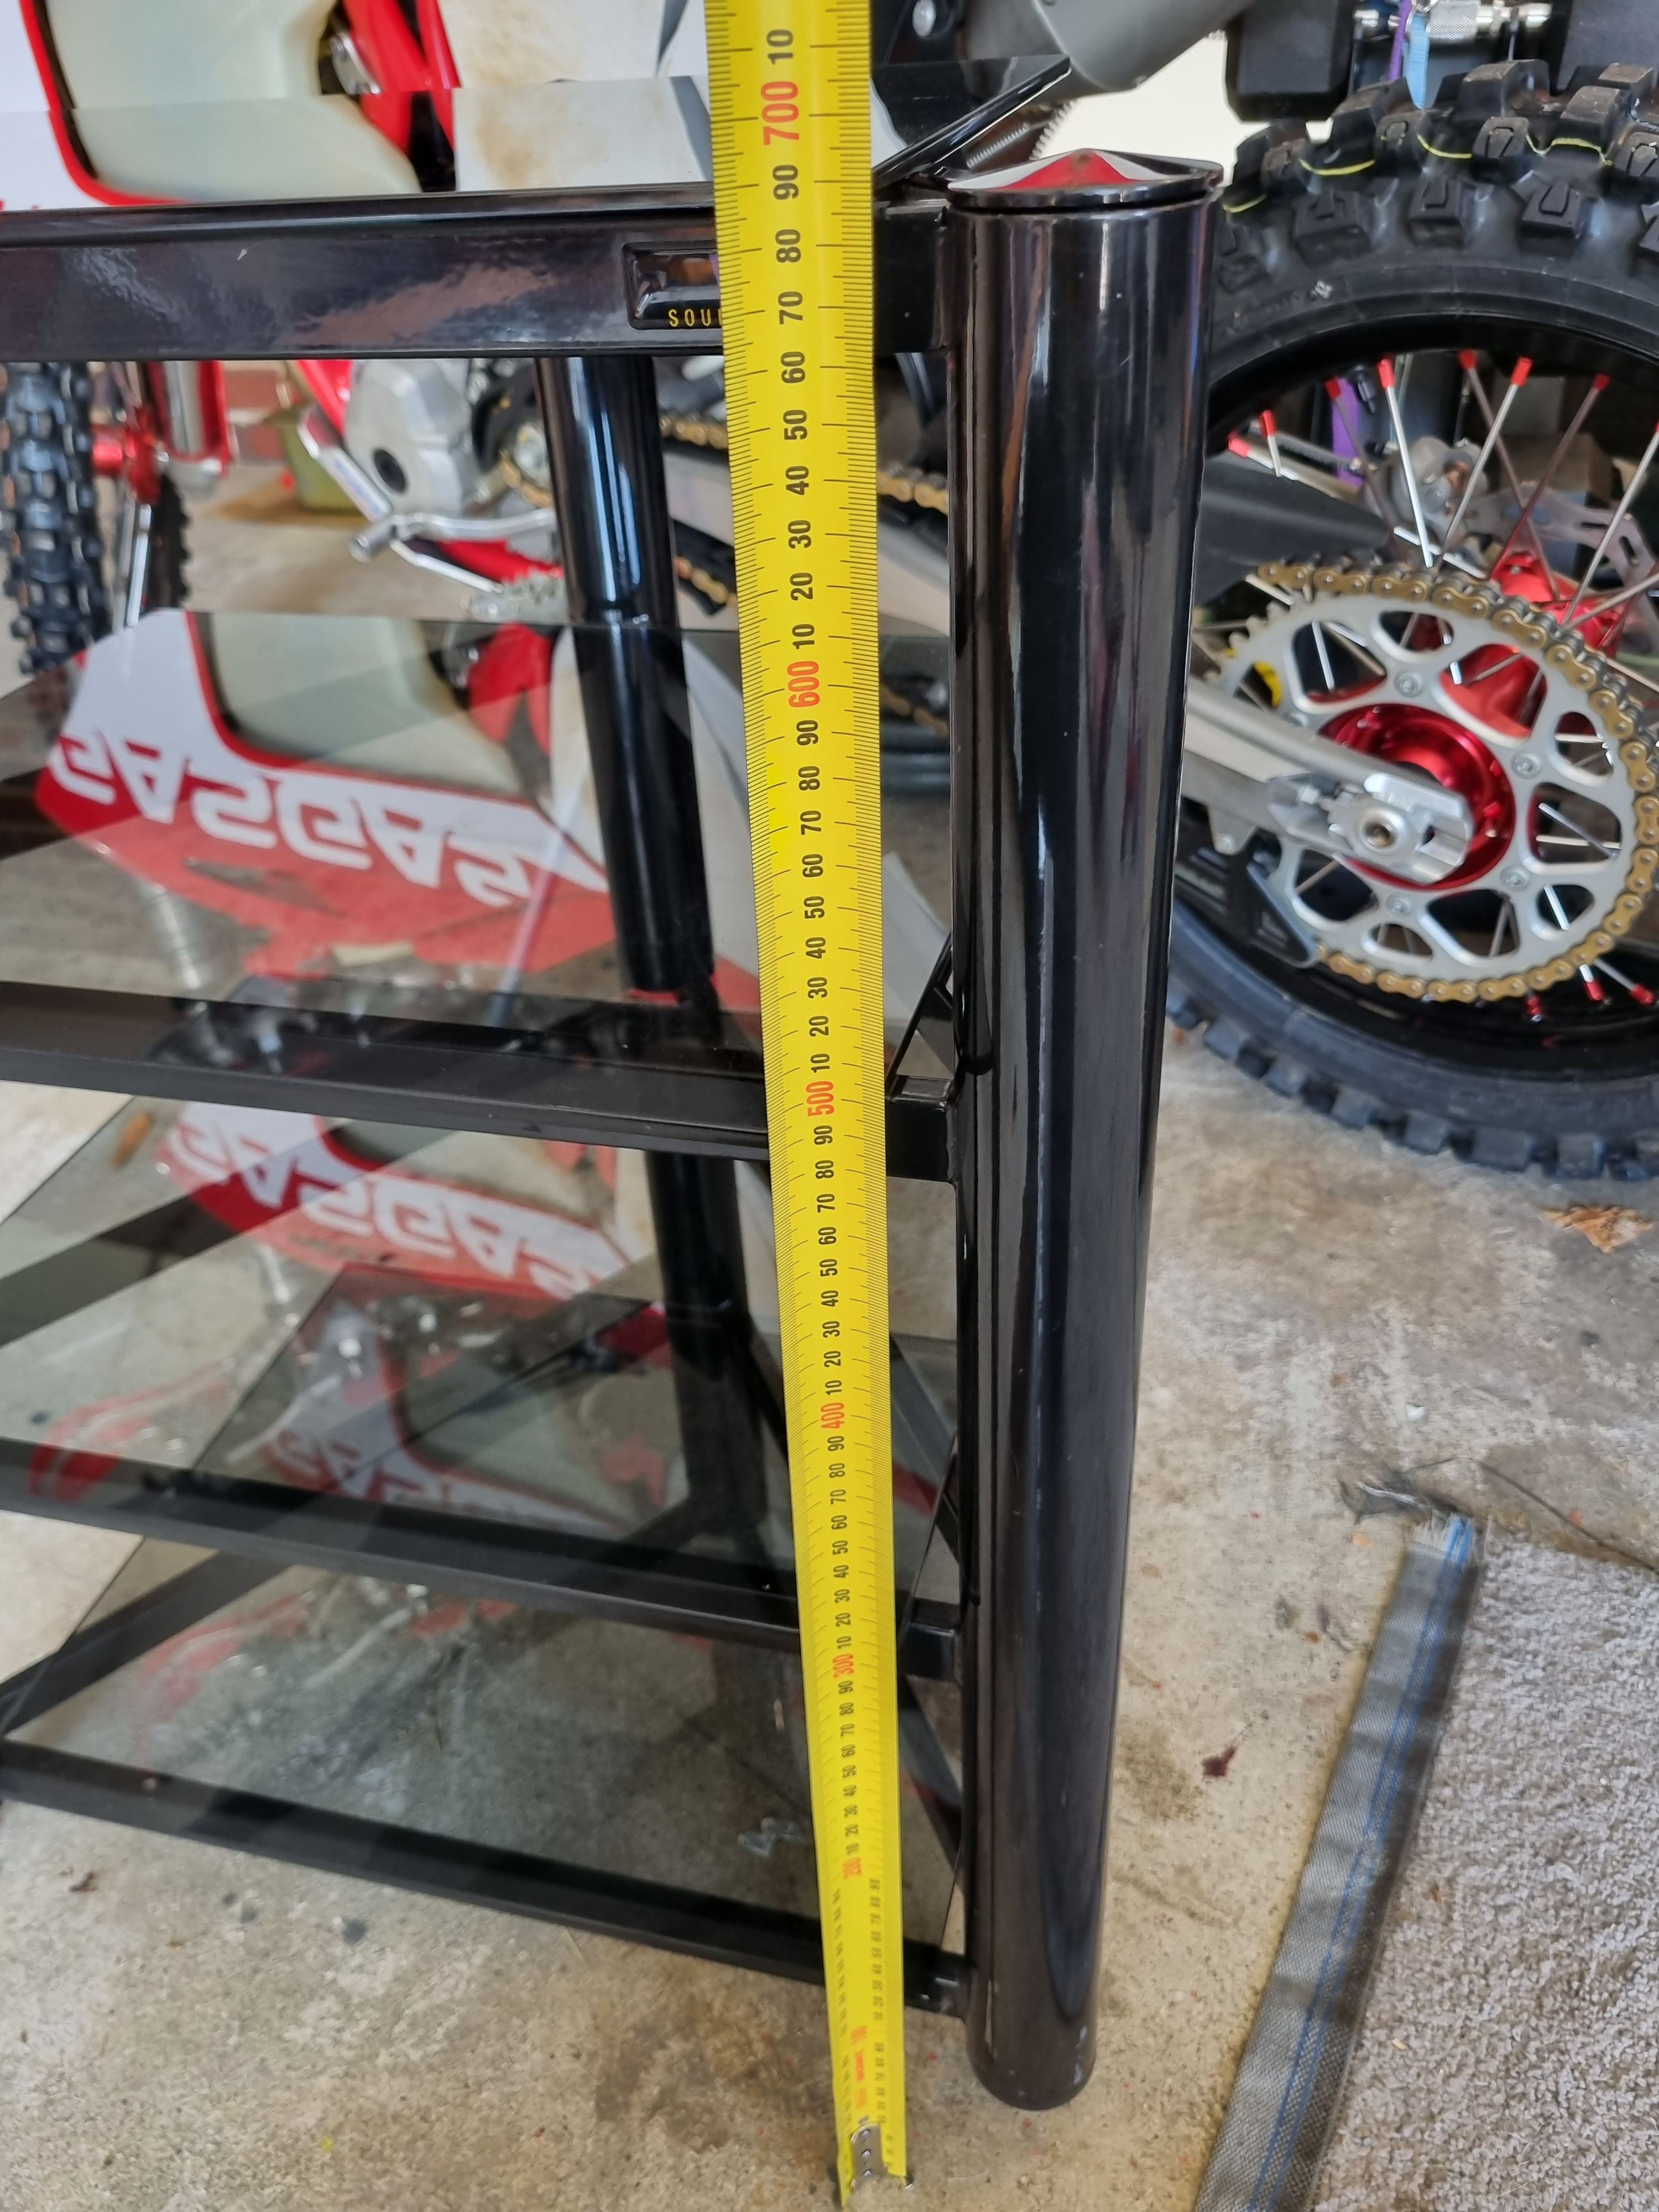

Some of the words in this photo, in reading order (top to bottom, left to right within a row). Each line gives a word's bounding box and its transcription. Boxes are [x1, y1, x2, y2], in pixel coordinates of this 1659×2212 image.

[766, 29, 794, 65] 10
[760, 81, 801, 146] 700
[772, 164, 800, 200] 90
[775, 229, 802, 263] 80
[668, 308, 722, 327] SOU
[778, 291, 804, 325] 70
[780, 351, 806, 384] 60
[782, 409, 808, 440] 50
[785, 466, 810, 495] 40
[787, 520, 812, 549] 30
[789, 572, 813, 601] 20
[791, 623, 815, 650] 10
[786, 660, 821, 708] 600
[796, 719, 819, 746] 90
[797, 765, 821, 791] 80
[800, 810, 822, 836] 70
[801, 854, 824, 878] 60
[803, 896, 825, 919] 50
[805, 937, 826, 959] 40
[807, 977, 828, 999] 30
[808, 1015, 829, 1037] 20
[810, 1053, 831, 1073] 10
[806, 1081, 835, 1117] 500
[813, 1125, 833, 1145] 90
[815, 1160, 834, 1180] 80
[816, 1193, 836, 1213] 70
[817, 1227, 837, 1245] 60
[819, 1259, 838, 1277] 50
[821, 1290, 839, 1307] 40
[822, 1321, 841, 1338] 30
[823, 1350, 841, 1368] 20
[825, 1380, 842, 1396] 10
[820, 1402, 845, 1429] 400
[827, 1436, 844, 1452] 90
[828, 1463, 846, 1478] 80
[830, 1489, 846, 1505] 70
[831, 1515, 847, 1530] 60
[832, 1540, 848, 1555] 50
[833, 1565, 849, 1578] 40
[834, 1589, 850, 1603] 30
[835, 1613, 851, 1627] 20
[836, 1636, 852, 1649] 10
[833, 1653, 855, 1679] 300
[838, 1681, 854, 1695] 90
[839, 1702, 854, 1716] 80
[840, 1723, 855, 1738] 70
